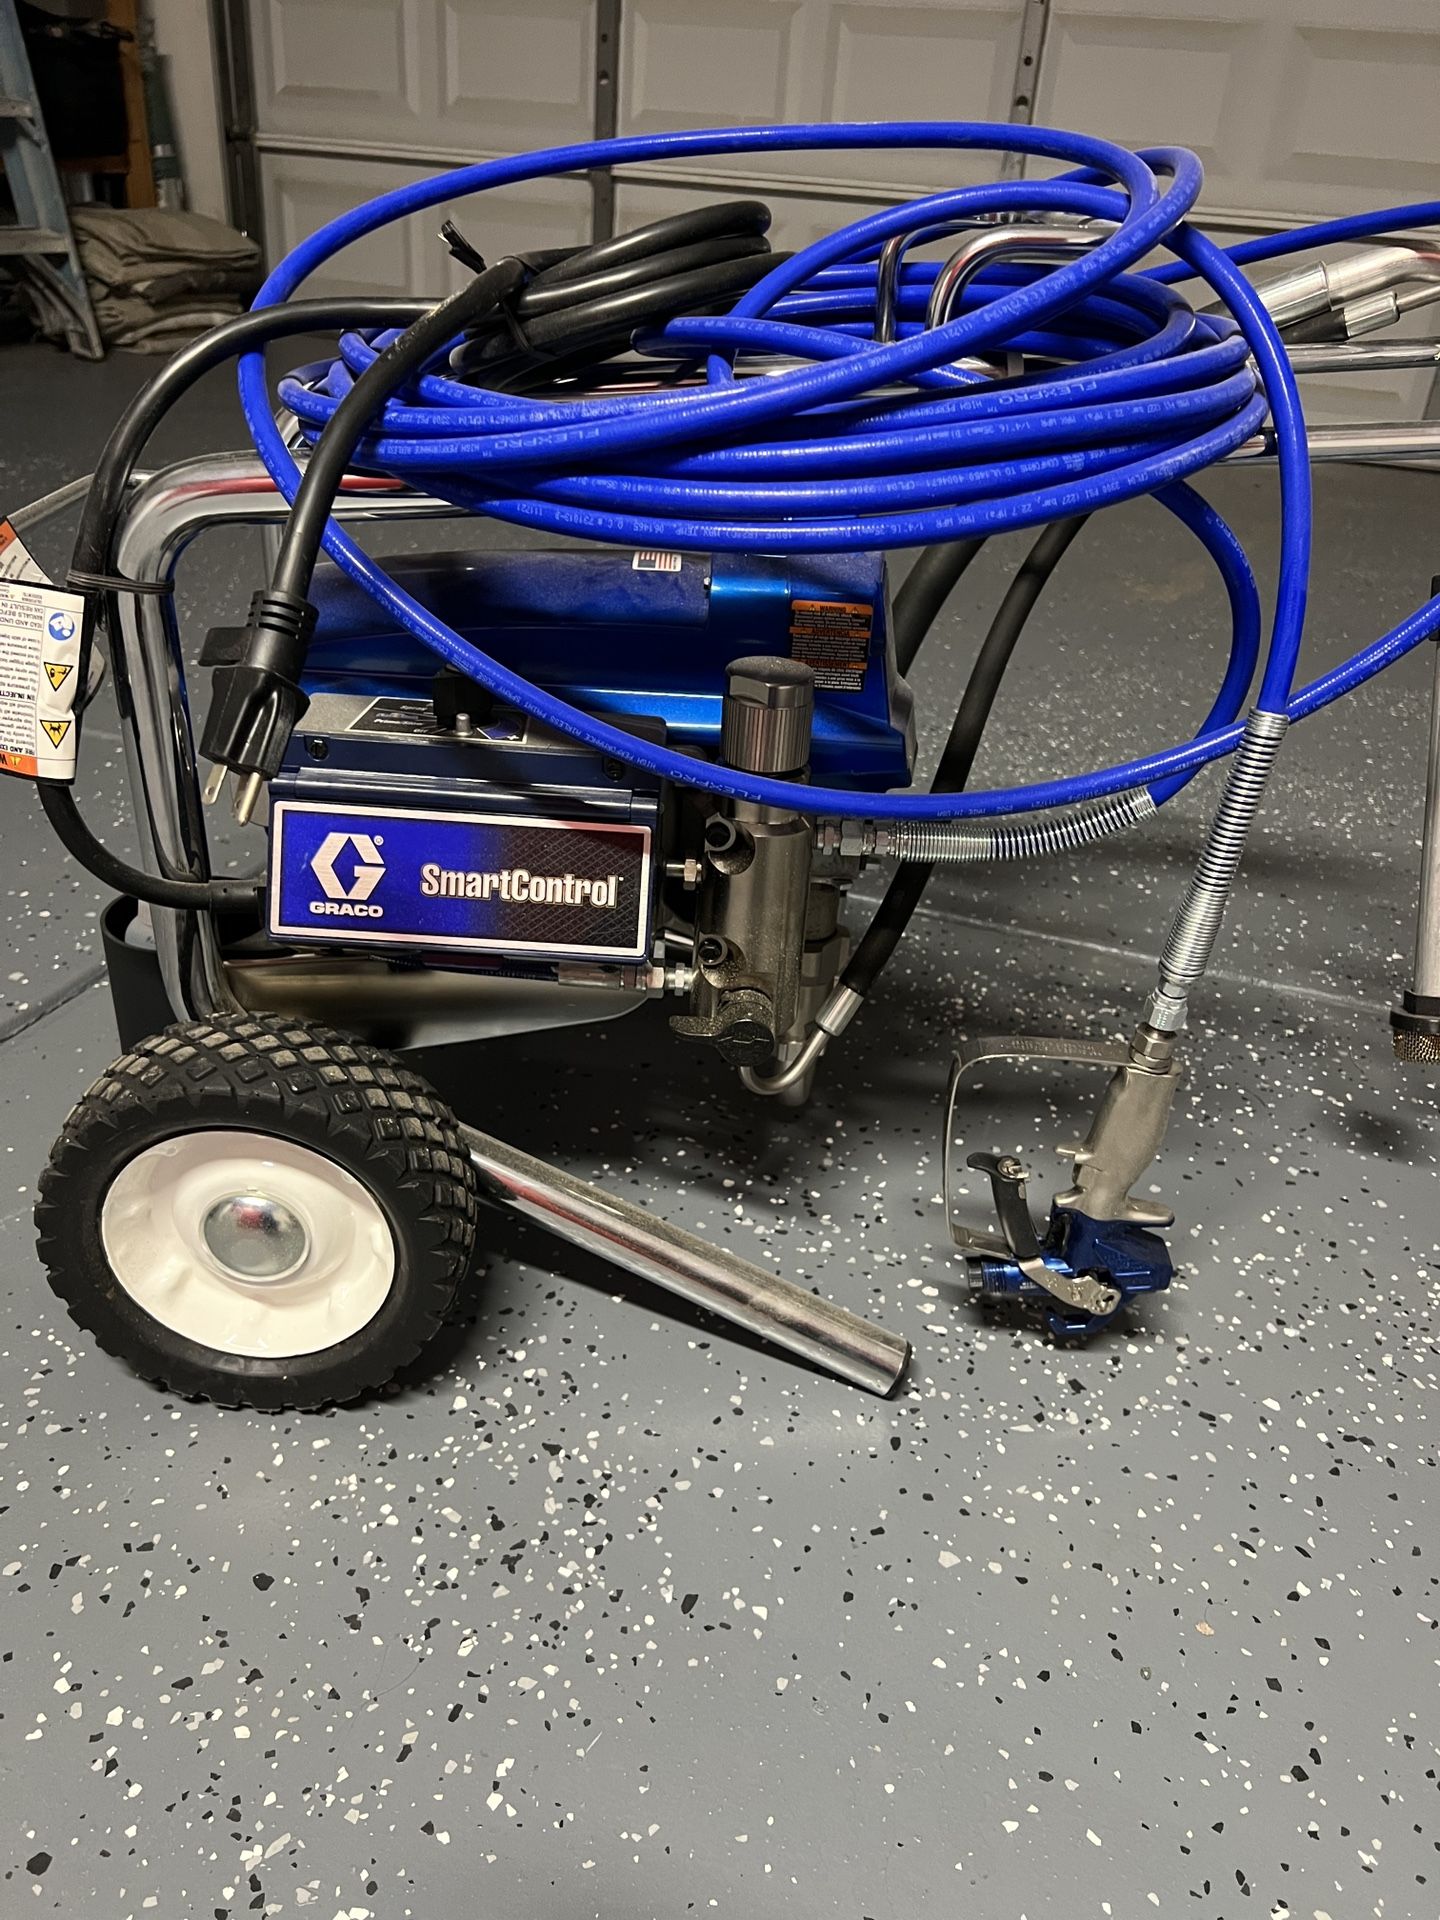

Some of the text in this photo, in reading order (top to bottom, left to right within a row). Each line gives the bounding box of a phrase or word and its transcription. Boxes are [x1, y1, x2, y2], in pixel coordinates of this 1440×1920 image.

[866, 351, 891, 368] MADE
[852, 362, 864, 373] IN
[998, 378, 1097, 407] FLEXPRO
[959, 398, 982, 411] HIGH
[1039, 416, 1057, 427] WPR
[1059, 414, 1076, 425] MAX
[493, 426, 600, 450] FLEXPRO
[413, 444, 458, 454] PERFORMANCE
[460, 442, 480, 453] HIGH
[1003, 464, 1016, 475] TO
[1084, 487, 1100, 499] PSI
[1101, 480, 1122, 494] 3300
[1059, 491, 1081, 505] (227
[516, 502, 544, 516] 111721
[984, 507, 1009, 521] MPa)
[1011, 502, 1033, 515] 22.7
[935, 516, 955, 527] WPR
[958, 513, 977, 524] MAX
[632, 520, 665, 533] 061465
[700, 527, 720, 537] MAX
[400, 614, 413, 626] TO
[412, 624, 451, 656] CONFORMS
[475, 669, 497, 687] HOSE
[496, 683, 522, 704] SPRAY
[521, 699, 549, 719] PAINT
[547, 712, 583, 737] AIRLESS
[582, 730, 635, 762] PERFORMANCE
[634, 754, 657, 772] HIGH
[668, 768, 762, 800] FLEXPRO
[951, 808, 964, 816] IN
[966, 807, 986, 815] MADE
[421, 863, 617, 909] SmartControl
[309, 900, 384, 918] GRACO
